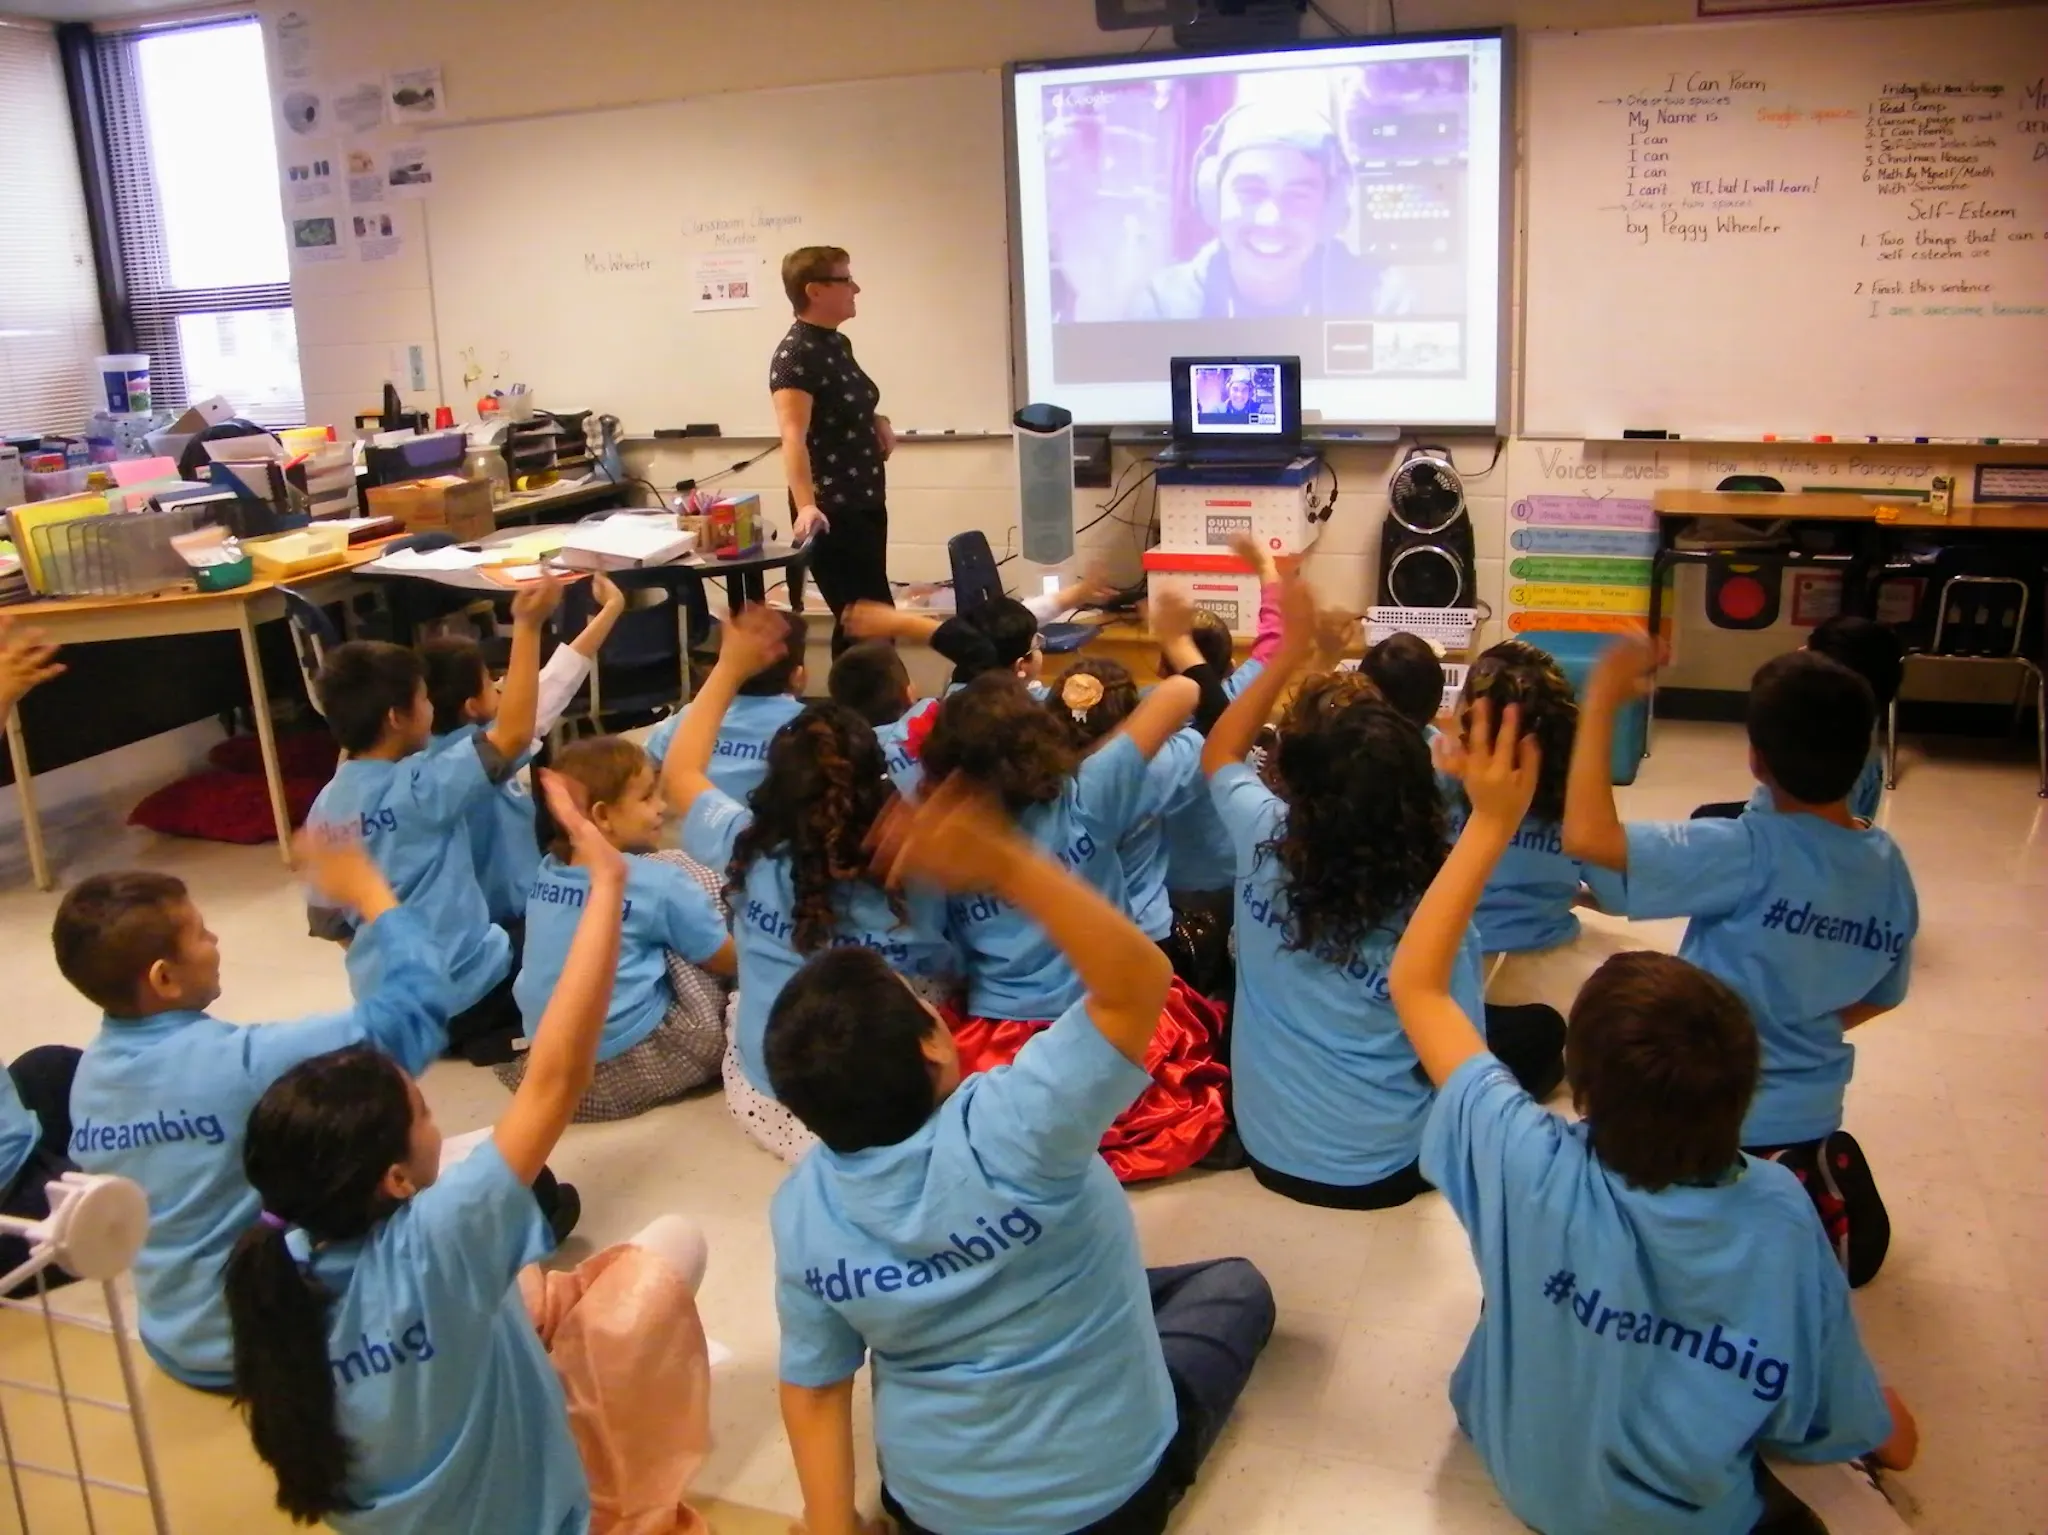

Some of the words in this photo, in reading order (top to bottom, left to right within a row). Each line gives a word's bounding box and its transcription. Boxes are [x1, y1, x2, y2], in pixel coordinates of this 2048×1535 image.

[1664, 72, 1677, 93] I
[1686, 71, 1720, 92] Can
[1728, 71, 1767, 92] Poem
[1628, 110, 1649, 133] My
[1656, 108, 1697, 124] Name
[1627, 132, 1637, 146] I
[1643, 136, 1669, 146] can
[1629, 150, 1638, 163] I
[1643, 152, 1670, 162] can
[1627, 166, 1637, 179] I
[1643, 168, 1667, 178] can
[1626, 184, 1636, 197] I
[1718, 177, 1738, 193] but
[1753, 179, 1775, 194] will
[1779, 176, 1819, 194] learn!
[1626, 214, 1649, 243] by
[1662, 209, 1708, 241] Peggy
[1716, 215, 1782, 234] Wheeler
[1877, 230, 1905, 246] Two
[1915, 228, 1957, 250] things
[1965, 228, 1997, 244] that
[2007, 232, 2034, 243] can
[1911, 248, 1963, 261] esteem
[1909, 278, 1935, 294] this
[1535, 447, 1598, 480] Voice
[1601, 448, 1671, 480] Levels
[1706, 457, 1737, 474] How
[1849, 456, 1935, 486] Paragraph
[805, 1206, 1042, 1303] #dreambig
[1543, 1269, 1789, 1402] #dreambig
